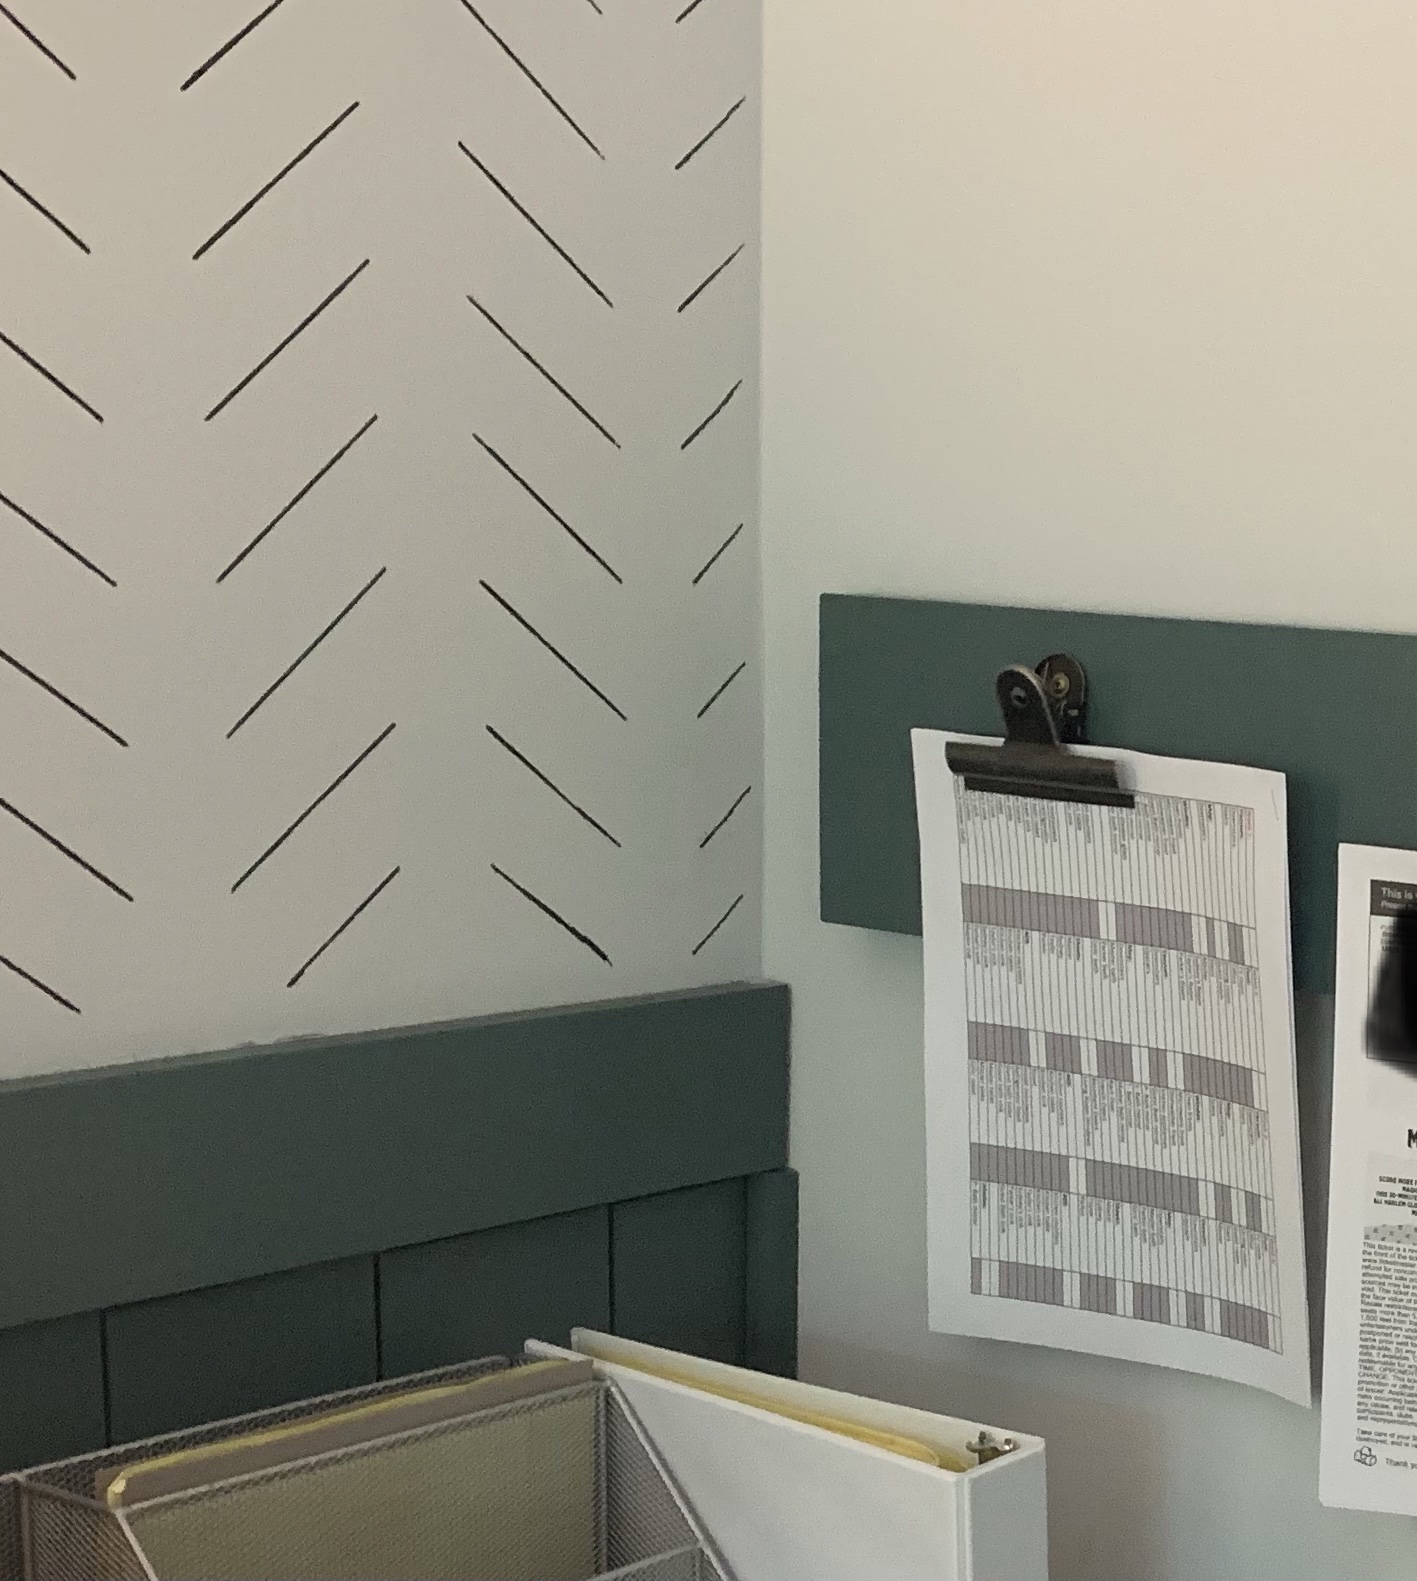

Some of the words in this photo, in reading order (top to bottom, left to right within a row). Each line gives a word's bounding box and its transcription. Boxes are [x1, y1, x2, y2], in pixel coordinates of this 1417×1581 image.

[1381, 887, 1401, 899] This
[1405, 889, 1413, 900] is
[1386, 1457, 1408, 1469] Thank
